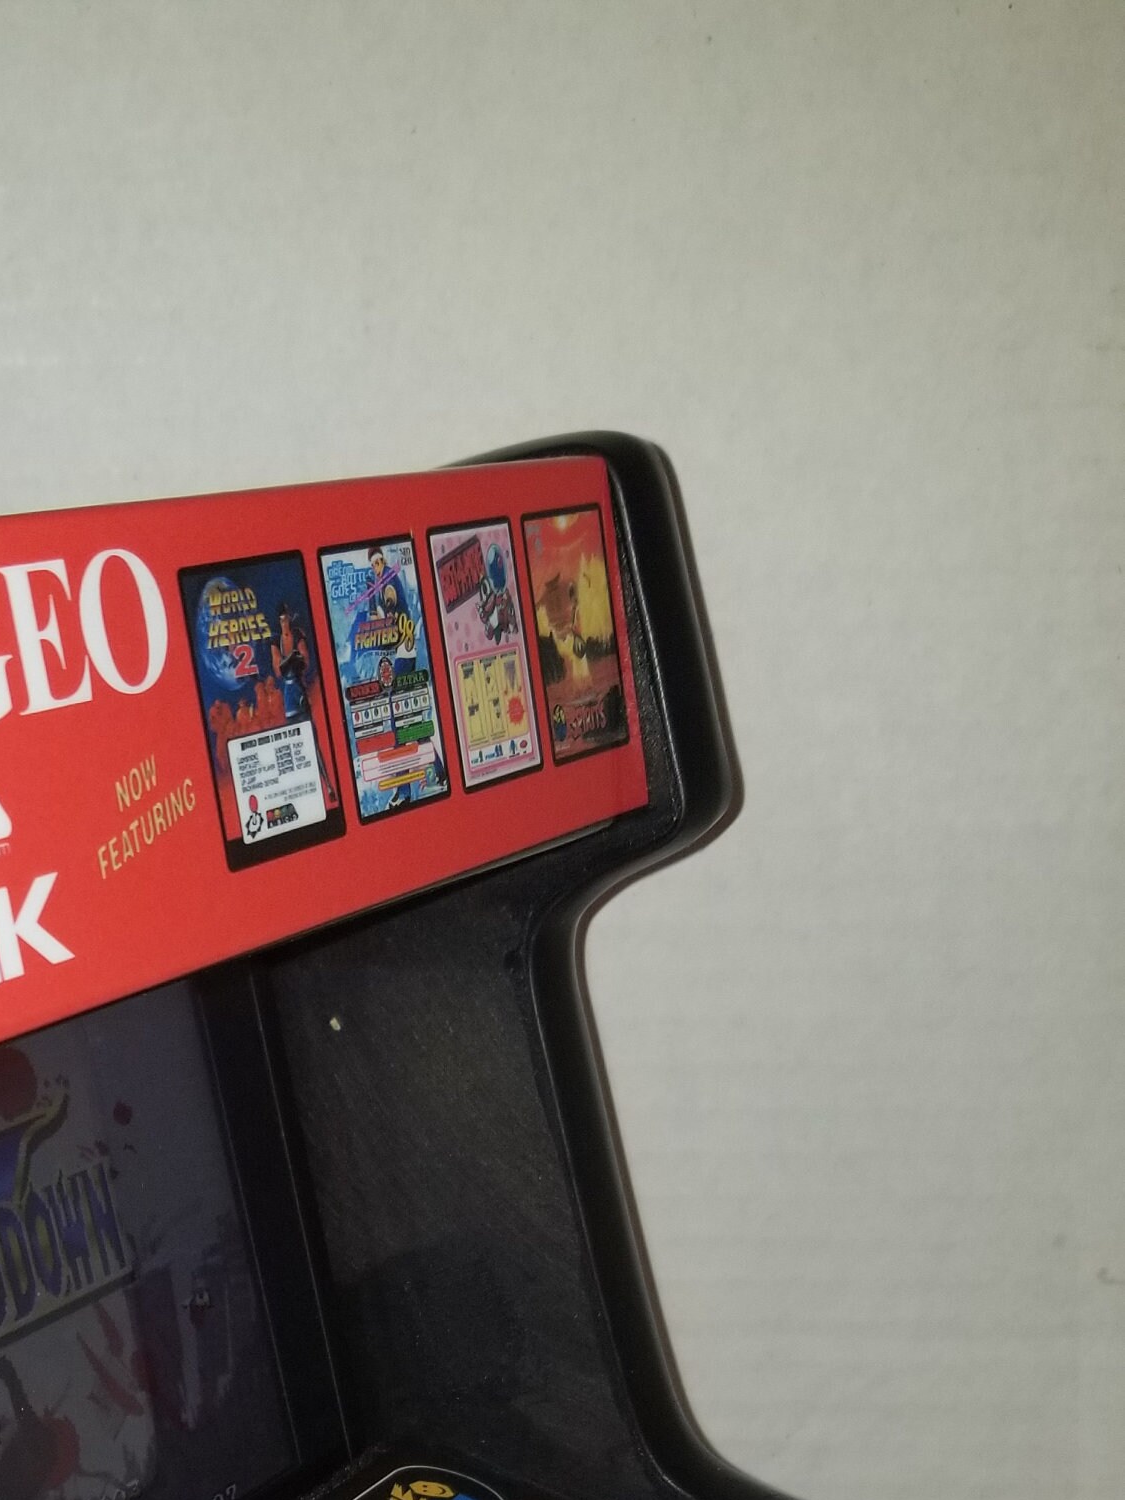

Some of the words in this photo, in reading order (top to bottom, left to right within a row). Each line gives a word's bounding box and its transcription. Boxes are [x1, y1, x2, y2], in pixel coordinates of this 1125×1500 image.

[208, 588, 257, 616] WORLD
[207, 613, 272, 649] HEROES
[234, 644, 260, 679] 2
[115, 754, 157, 812] NOW
[97, 777, 196, 880] FEATURING
